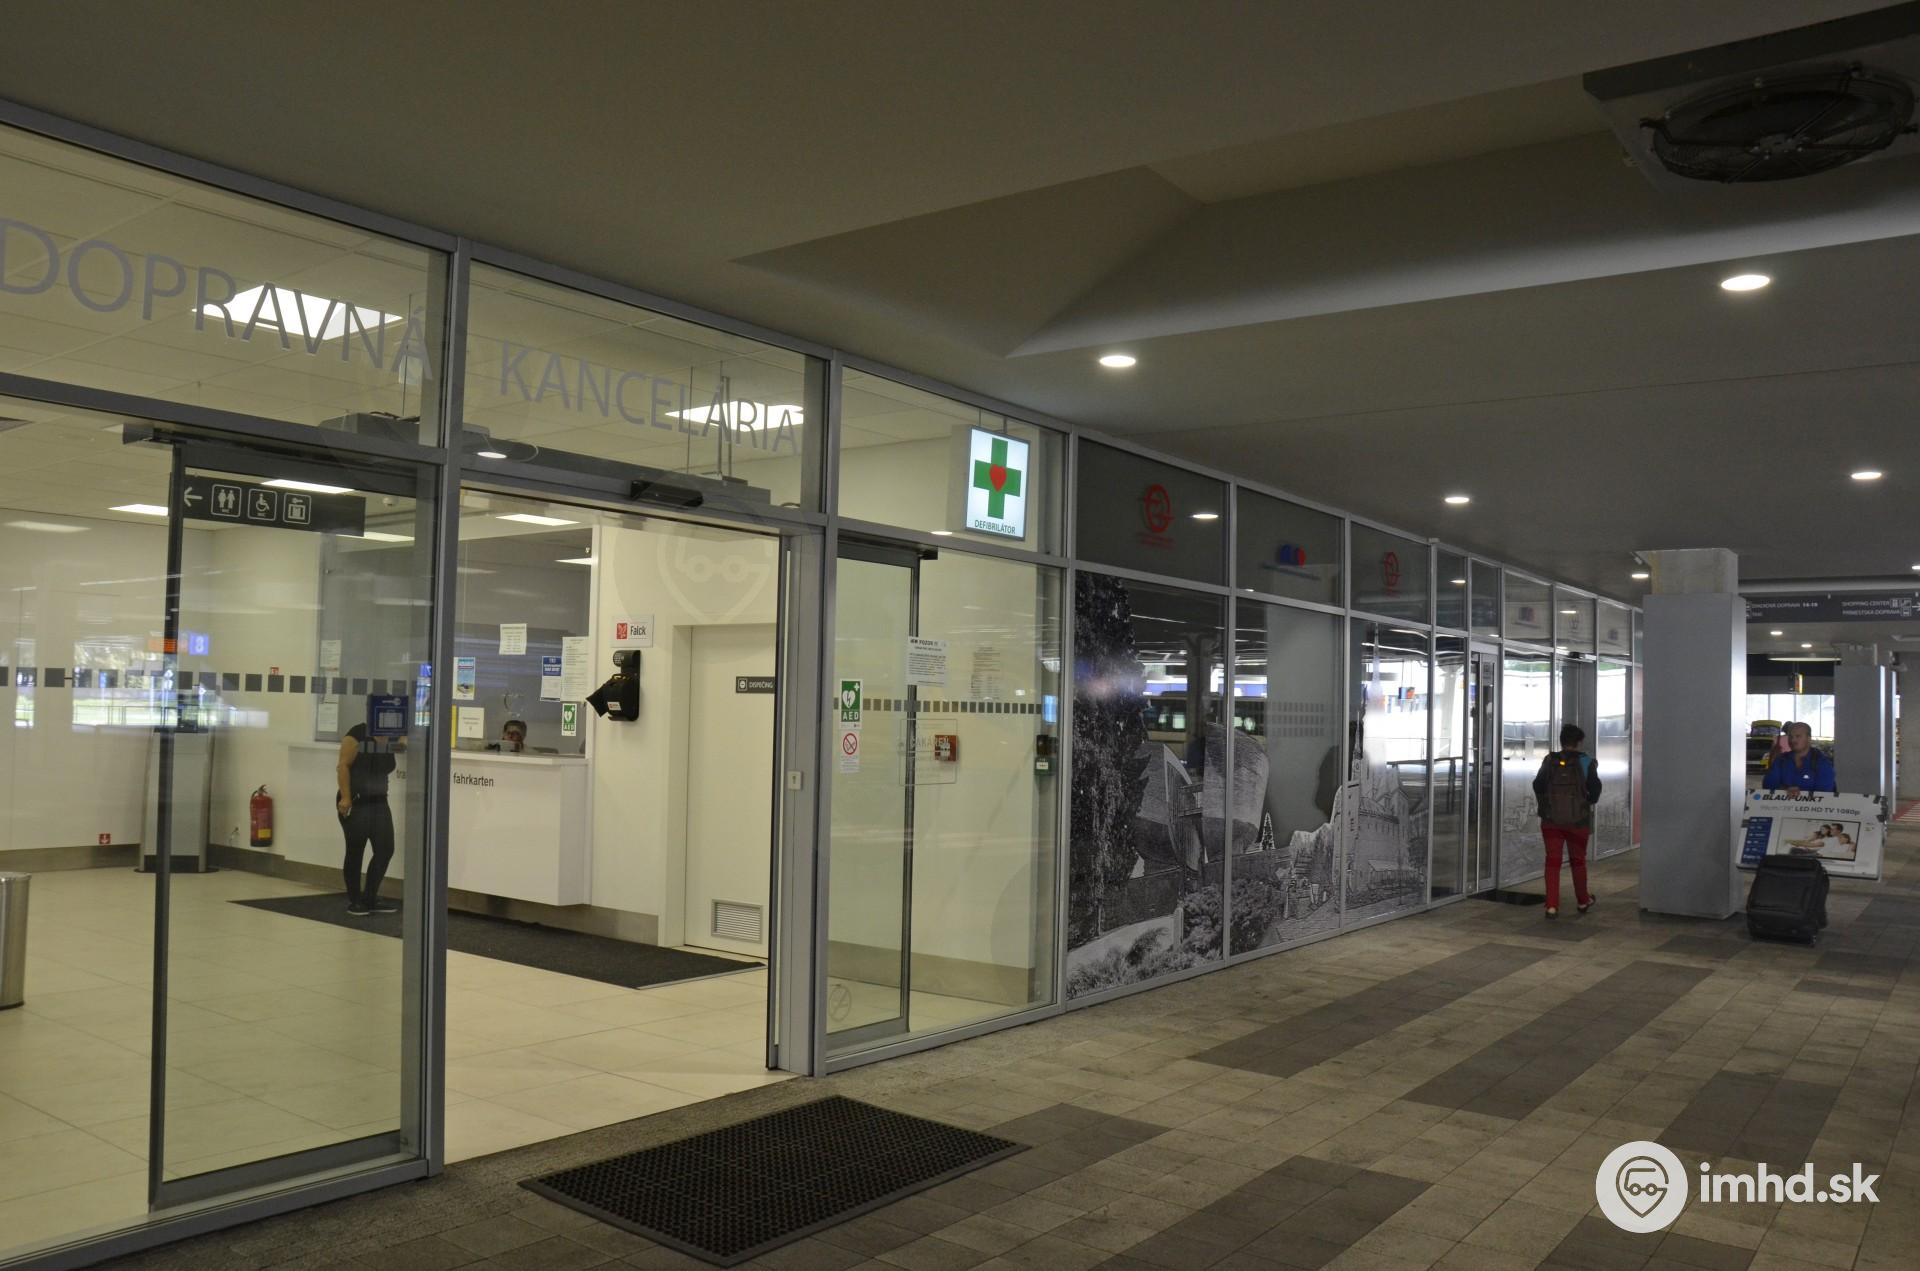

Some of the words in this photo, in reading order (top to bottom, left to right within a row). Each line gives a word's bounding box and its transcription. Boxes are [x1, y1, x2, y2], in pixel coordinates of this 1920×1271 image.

[0, 217, 433, 380] DOPRAVNÁ
[500, 339, 799, 455] KANCELÁRIA
[974, 518, 1016, 535] DEFIBRILÁTOR
[630, 625, 647, 636] Falck
[842, 711, 859, 720] AED
[453, 772, 494, 787] fahrkarten
